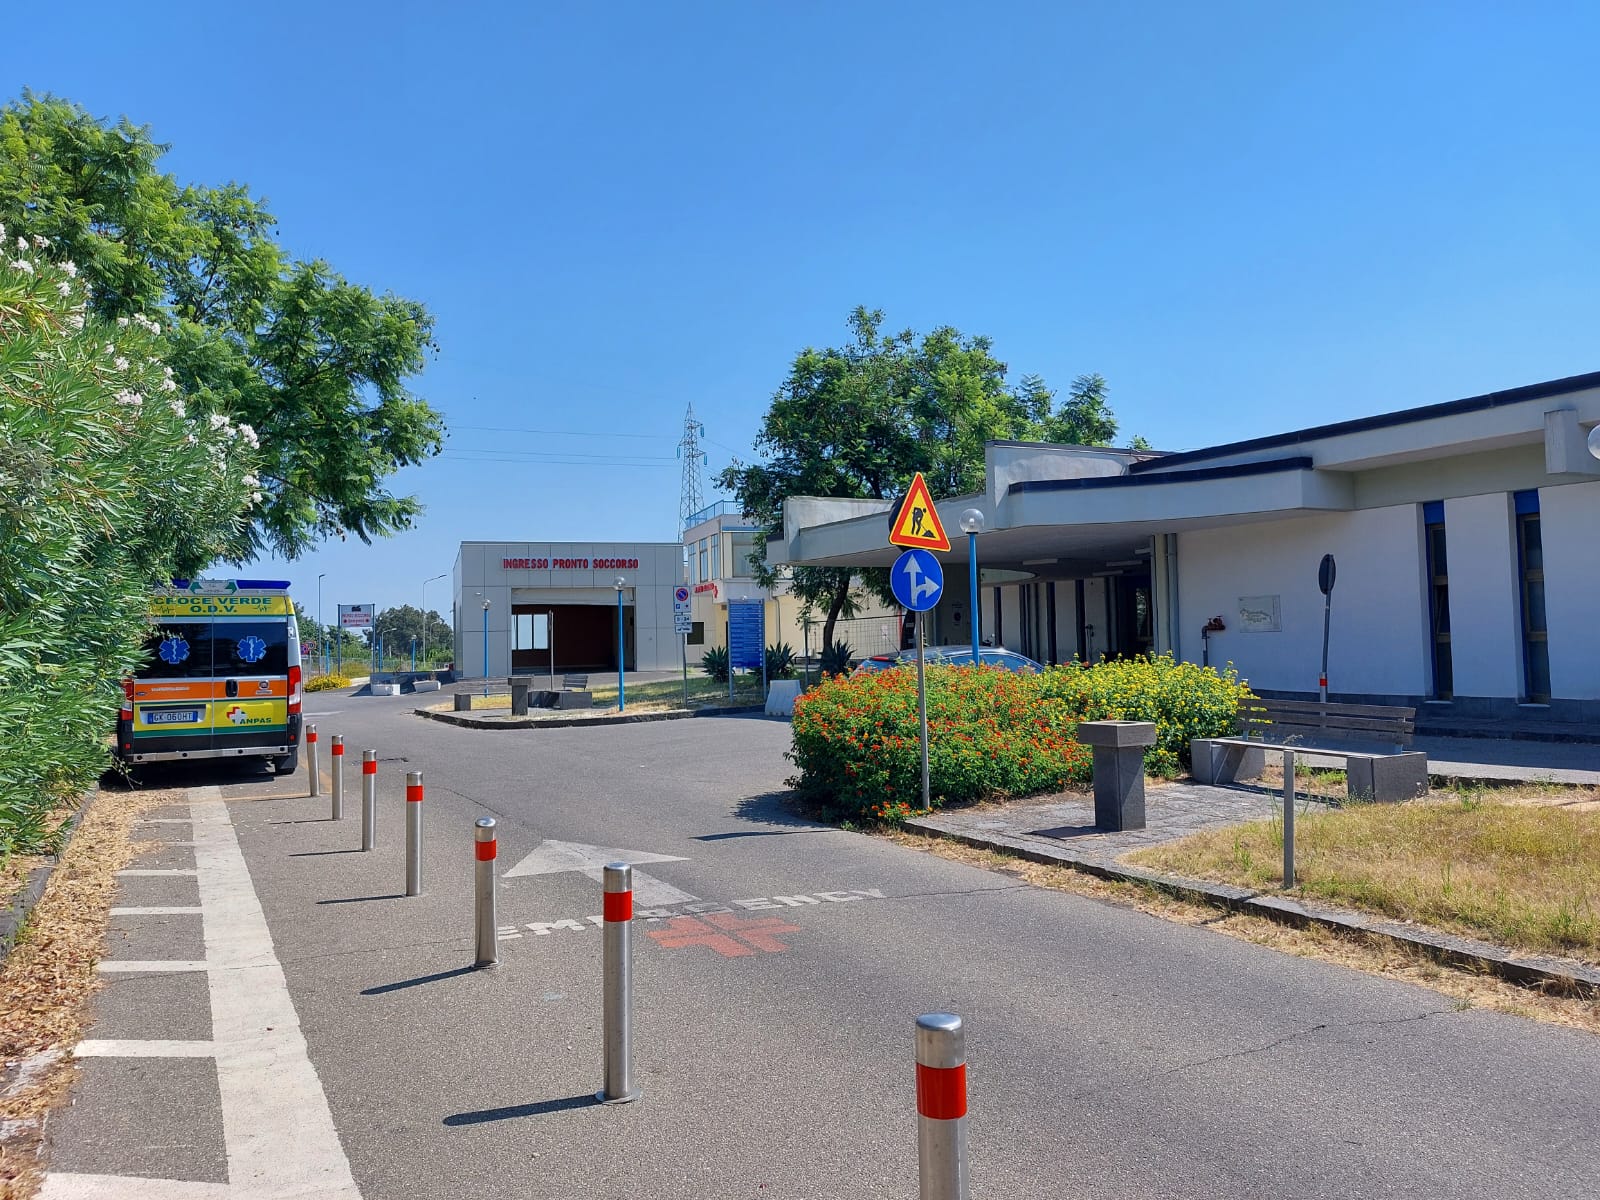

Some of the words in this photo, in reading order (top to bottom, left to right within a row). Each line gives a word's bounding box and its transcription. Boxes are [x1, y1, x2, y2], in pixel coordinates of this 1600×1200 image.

[503, 558, 549, 569] INGRESSO
[553, 558, 588, 569] PRONTO
[592, 558, 638, 569] SOCCORSO
[217, 597, 272, 605] VERDE
[190, 605, 237, 613] O.D.V.
[240, 717, 272, 725] ANPAS
[497, 889, 886, 940] EMRGENCY
